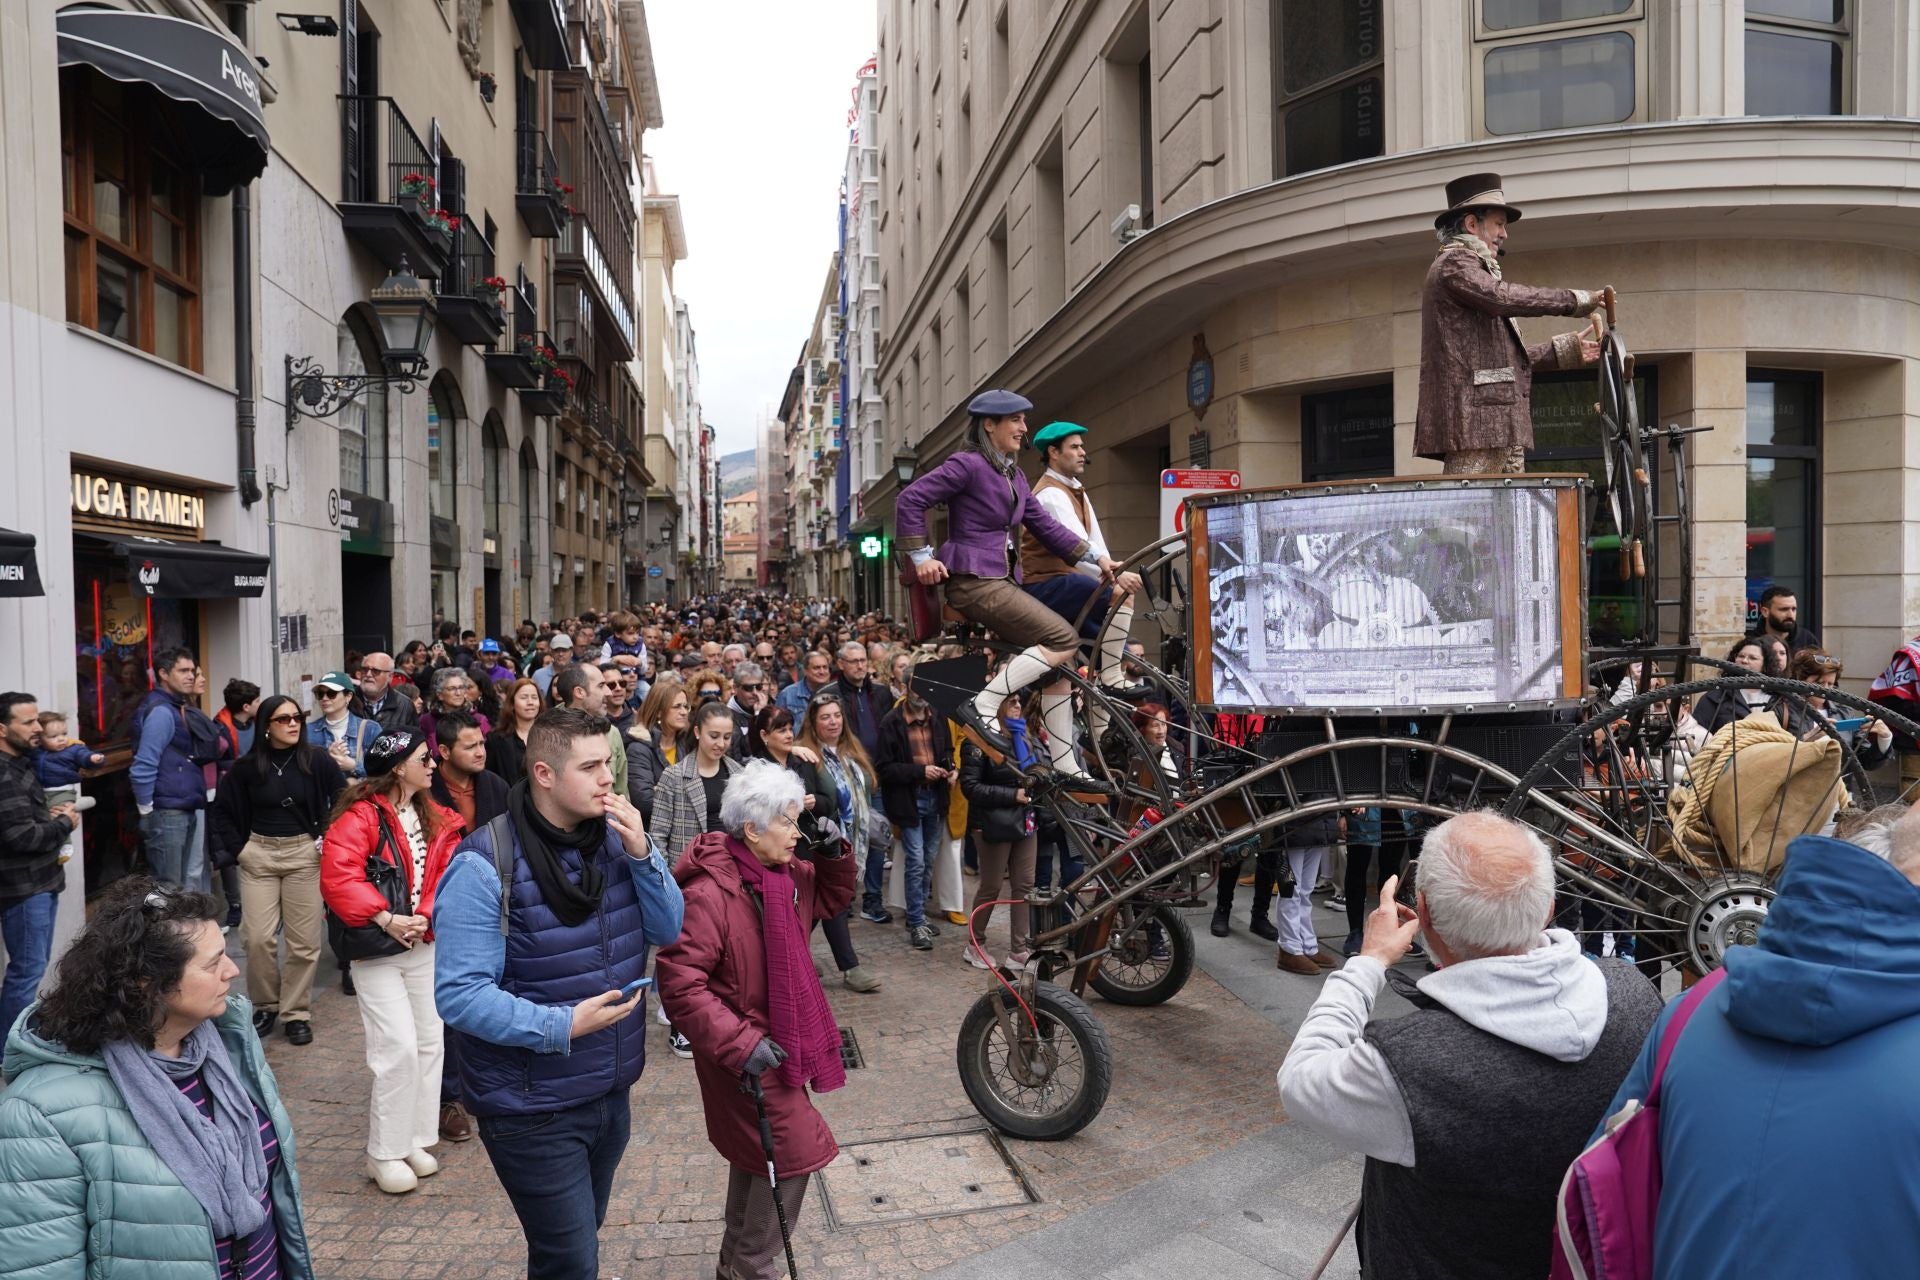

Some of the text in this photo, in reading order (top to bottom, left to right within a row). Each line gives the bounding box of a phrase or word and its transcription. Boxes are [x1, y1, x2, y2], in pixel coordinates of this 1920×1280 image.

[71, 474, 204, 529] UGA RAMEN
[331, 496, 337, 519] 3
[234, 575, 249, 586] BUGA
